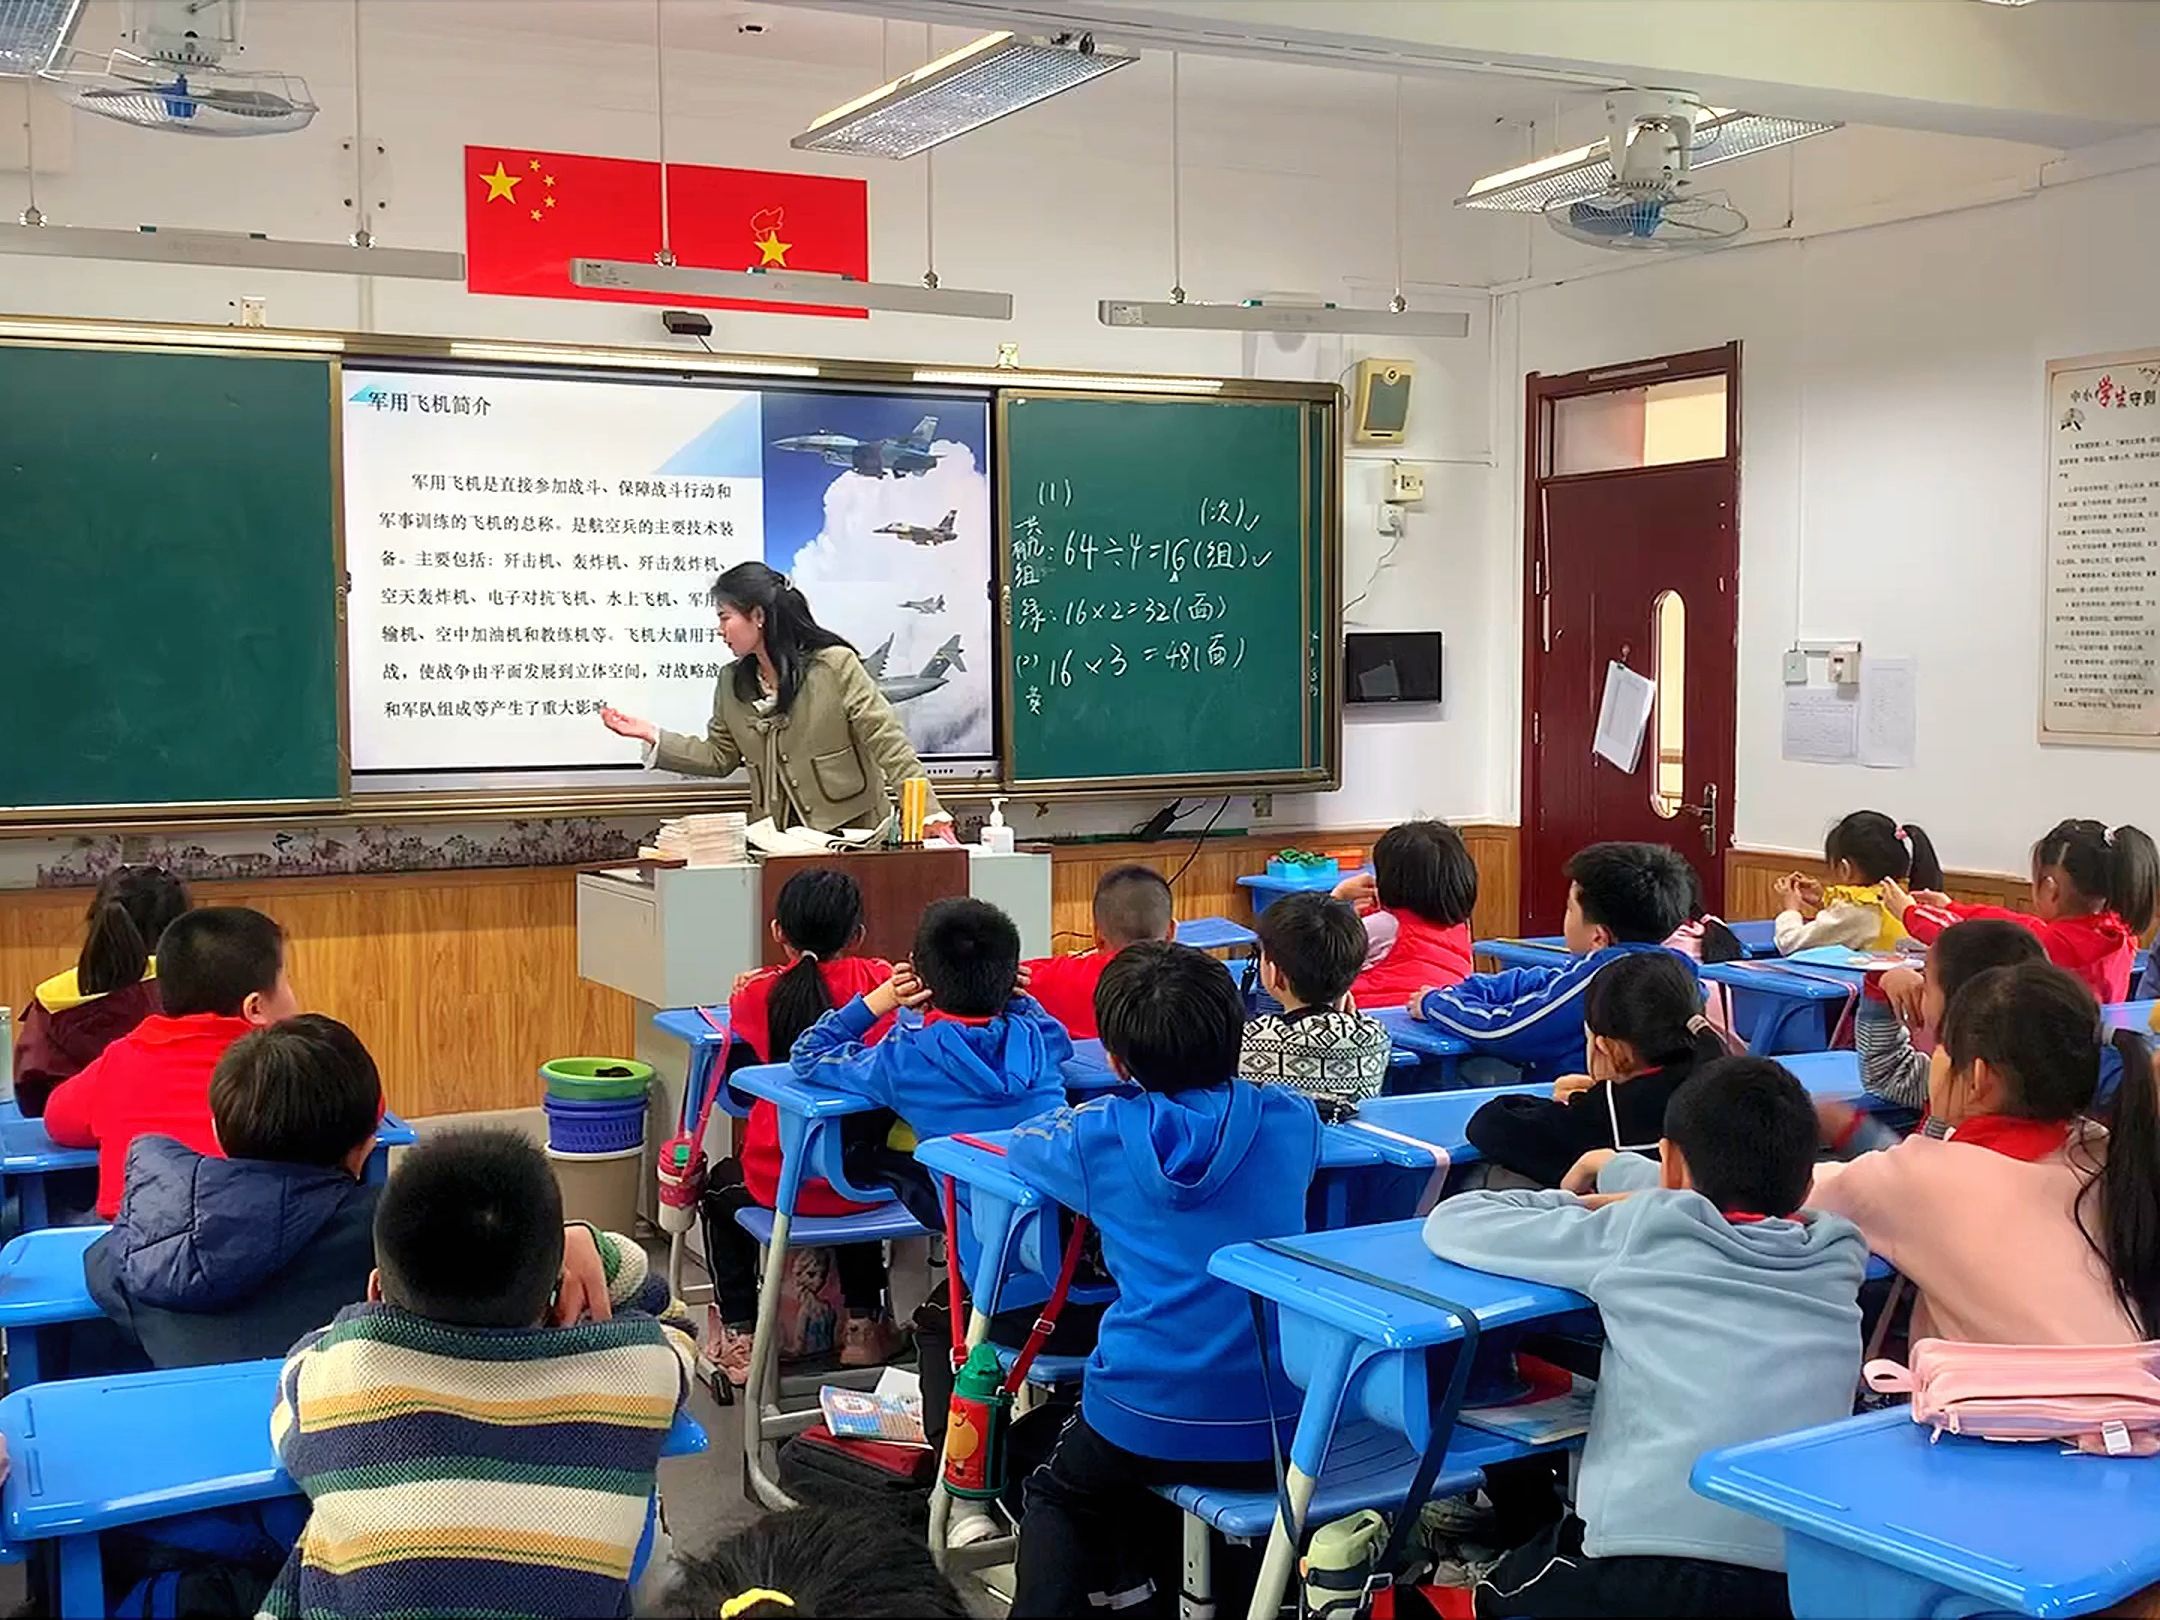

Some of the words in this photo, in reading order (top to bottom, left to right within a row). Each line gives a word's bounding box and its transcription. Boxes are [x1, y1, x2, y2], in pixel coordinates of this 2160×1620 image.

[368, 391, 491, 416] 军用飞机简介
[411, 473, 732, 500] 军用飞机是直接参加战斗、保障战斗行动和
